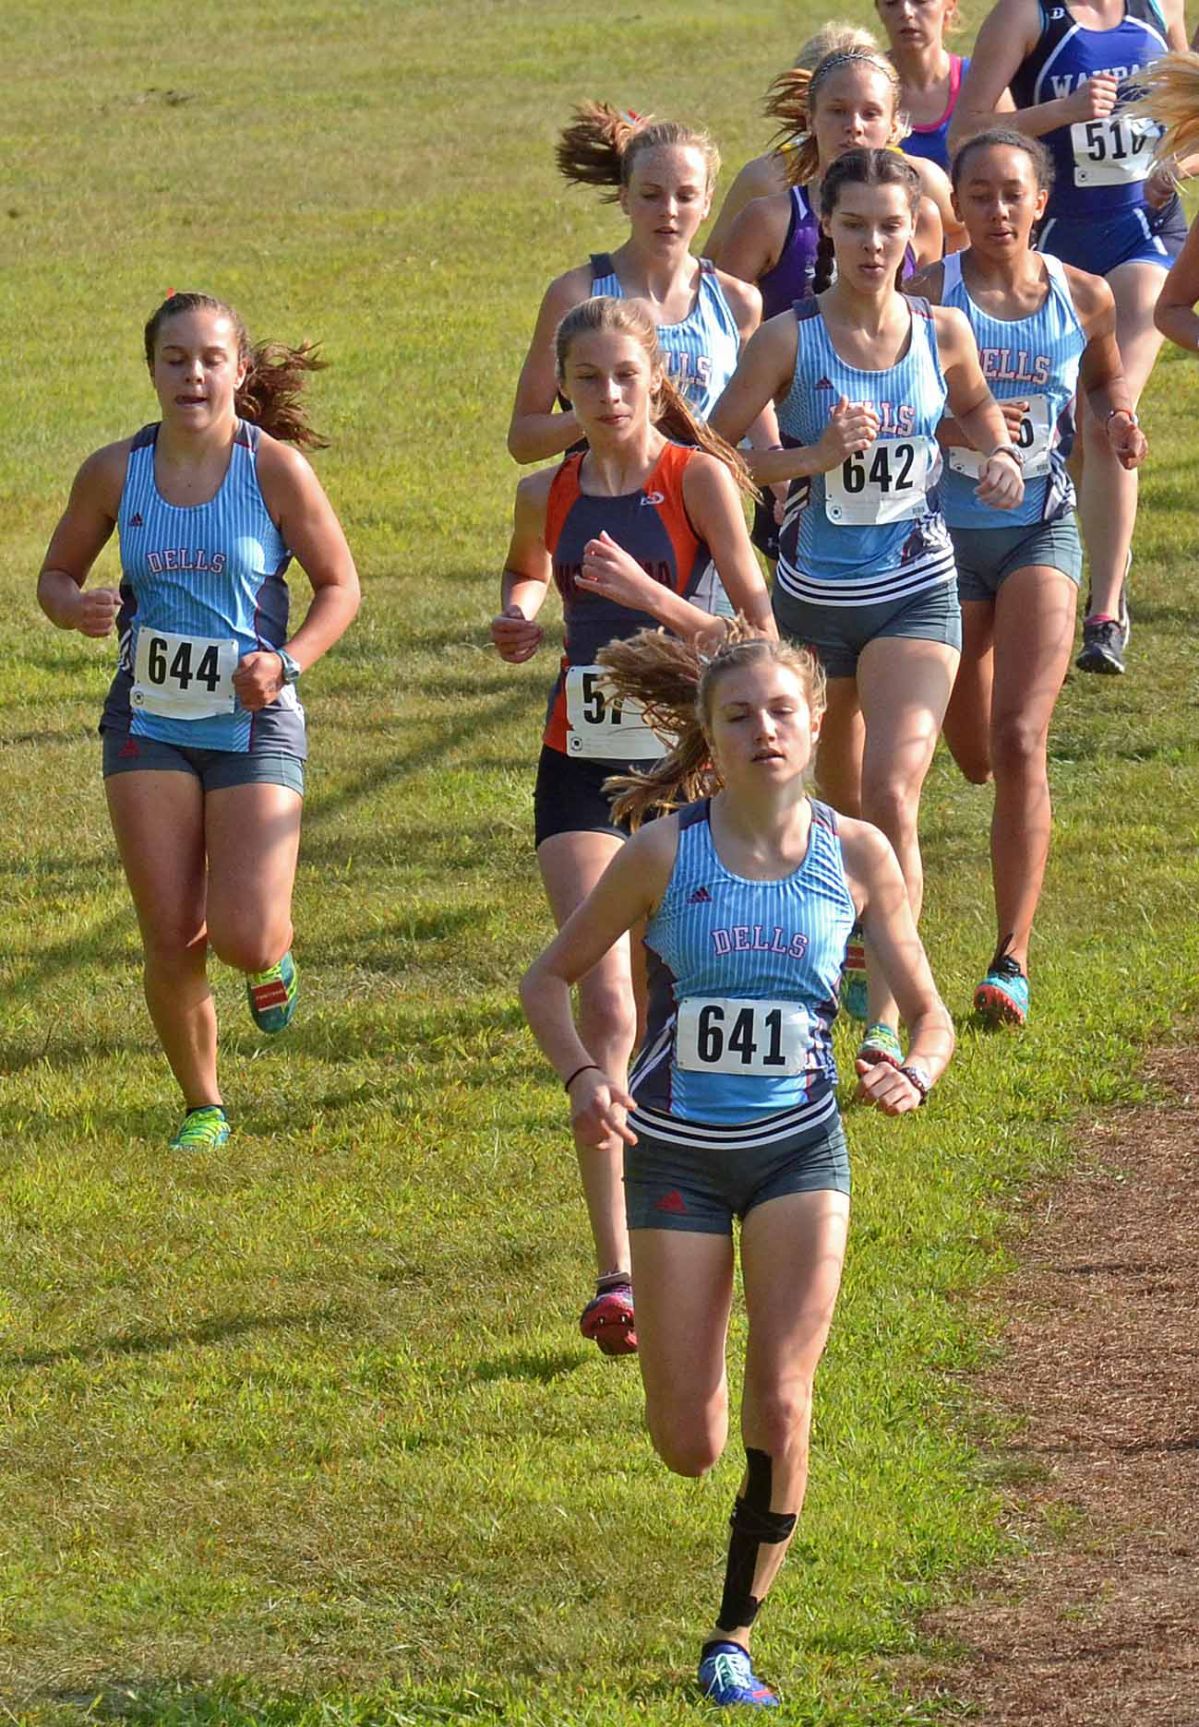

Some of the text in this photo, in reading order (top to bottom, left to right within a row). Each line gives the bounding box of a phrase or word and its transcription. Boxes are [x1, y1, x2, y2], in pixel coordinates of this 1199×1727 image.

[978, 348, 1050, 385] ELLS
[843, 443, 915, 494] 642
[147, 548, 226, 574] DELLS
[148, 637, 221, 692] 644
[711, 925, 809, 960] DELLS
[697, 1005, 786, 1066] 641
